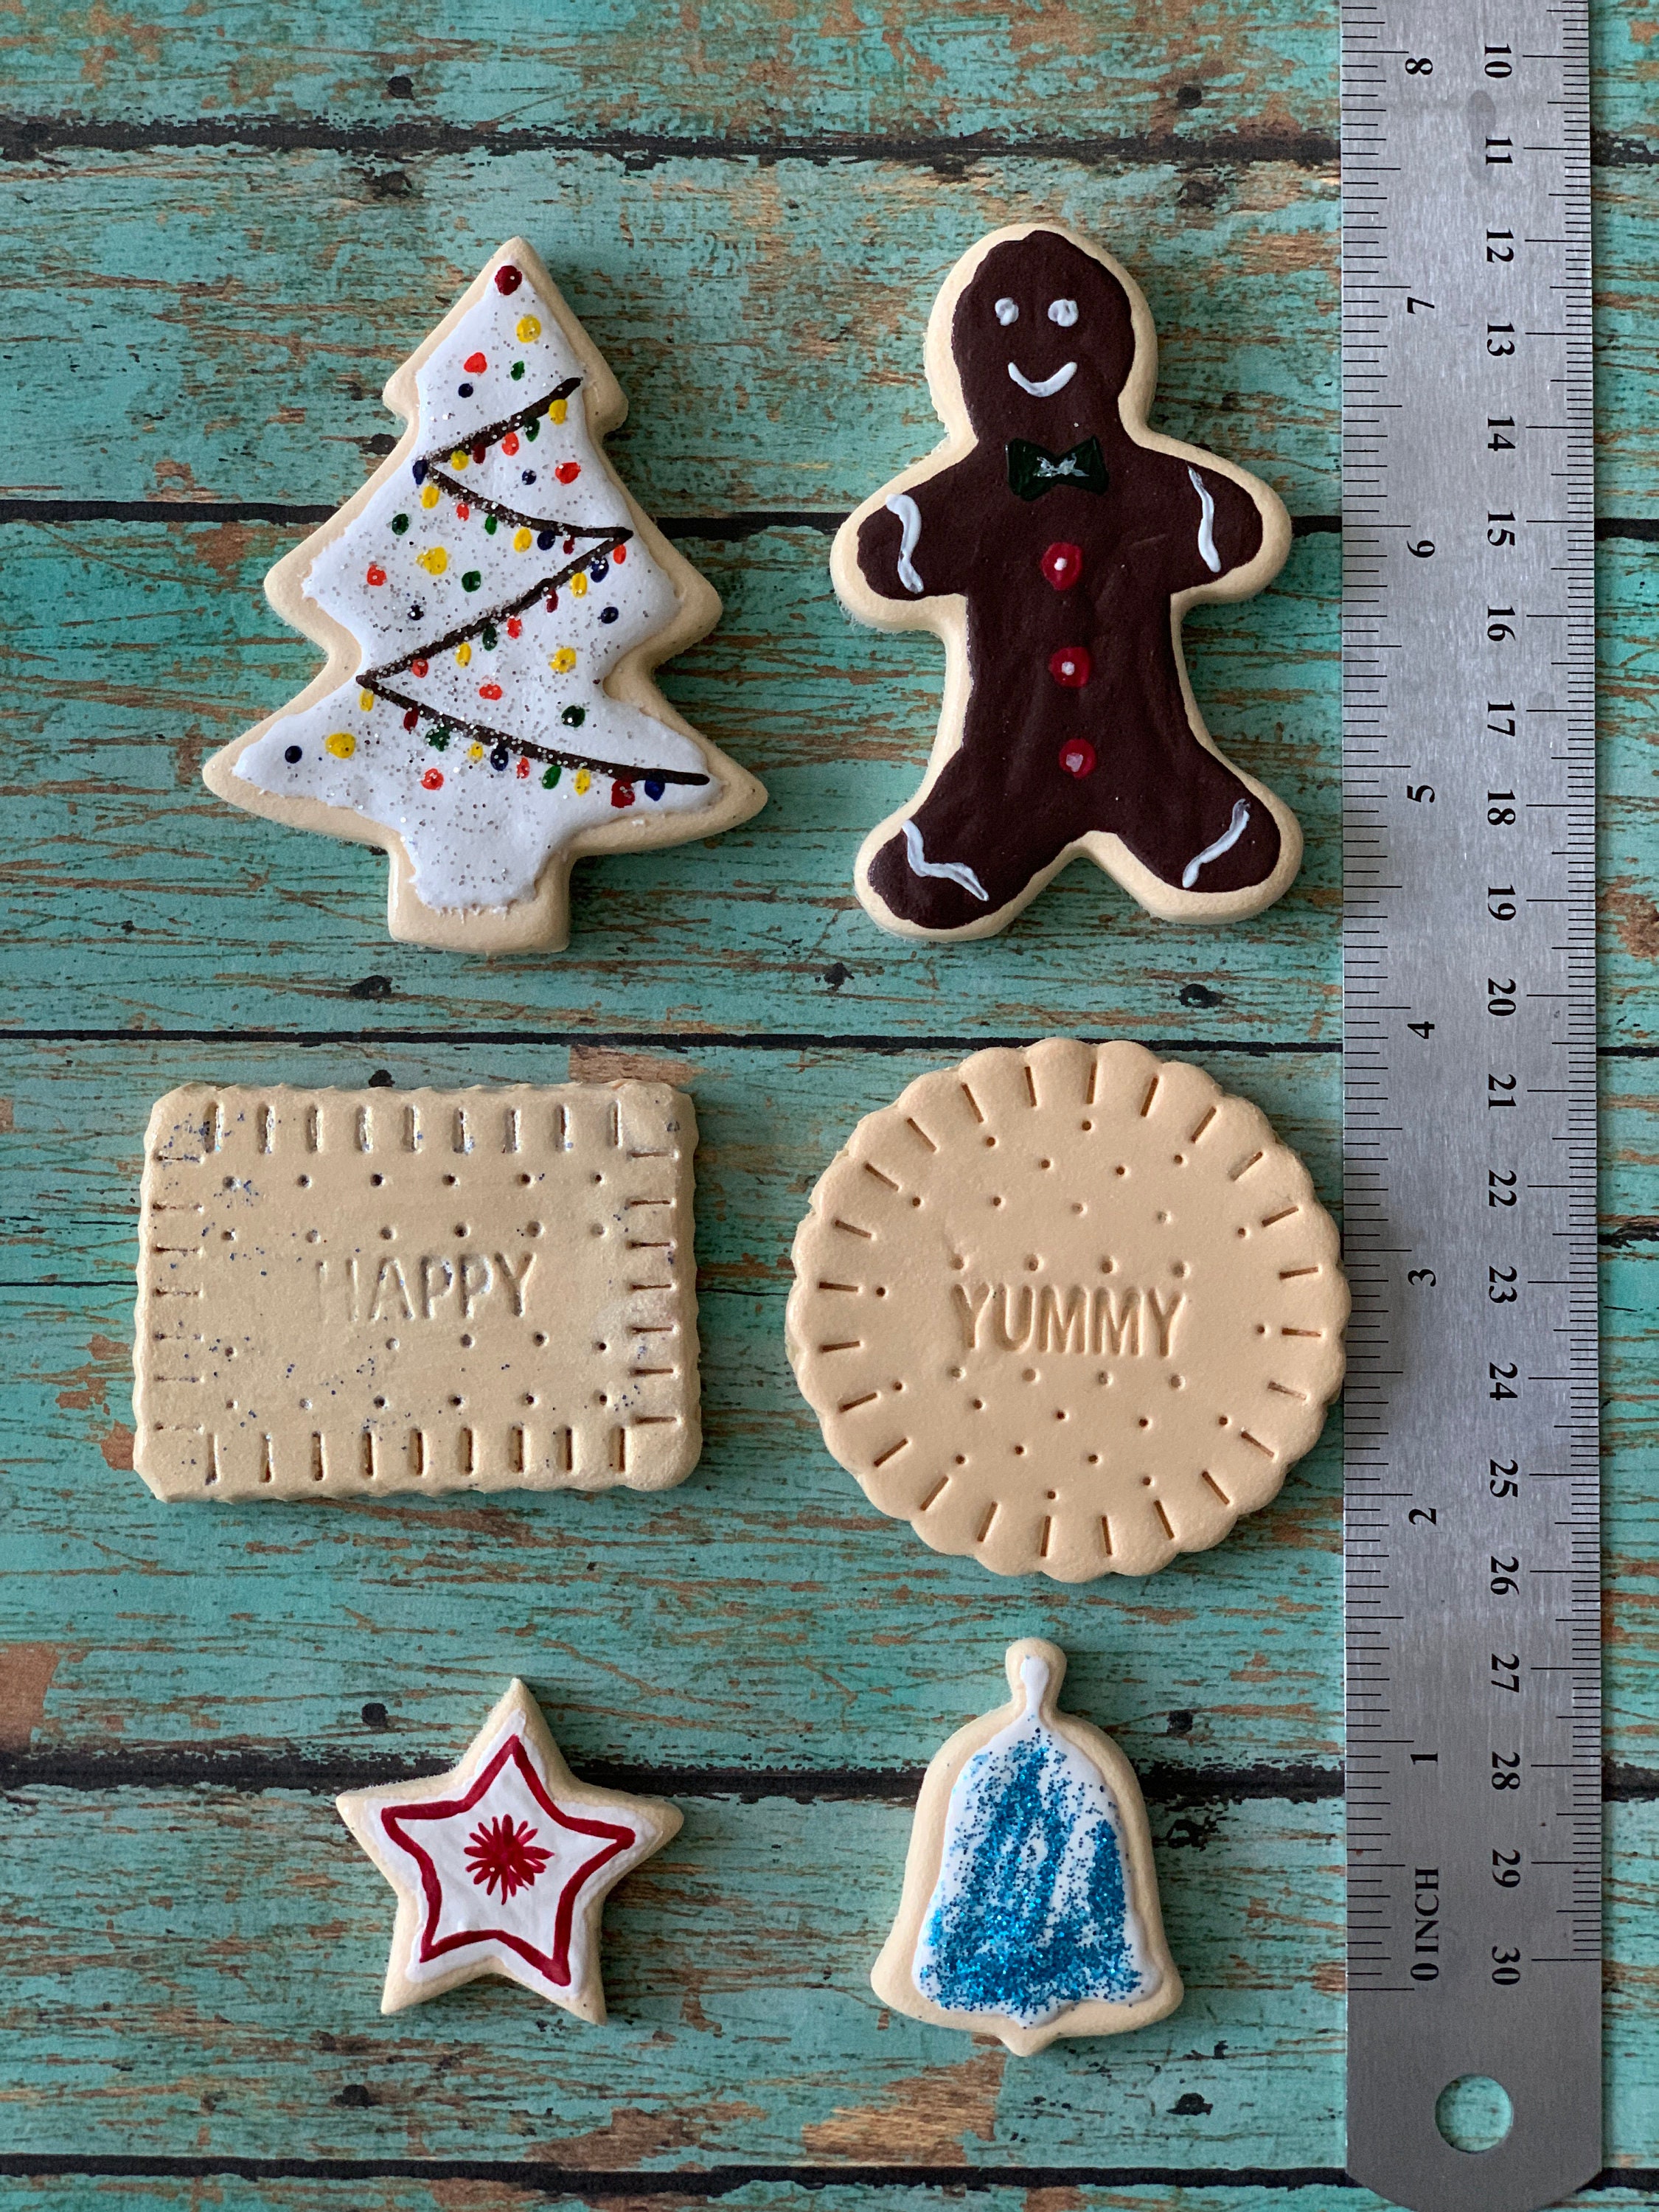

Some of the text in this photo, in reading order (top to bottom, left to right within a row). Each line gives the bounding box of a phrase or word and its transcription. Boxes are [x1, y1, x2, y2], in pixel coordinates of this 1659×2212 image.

[1405, 58, 1433, 76] 8
[1484, 43, 1513, 79] 10
[1484, 136, 1514, 166] 11
[1486, 228, 1514, 264] 12
[1407, 296, 1436, 315] 7
[1486, 321, 1515, 357] 13
[1487, 415, 1516, 452] 14
[1486, 510, 1516, 547] 15
[1406, 540, 1436, 558] 6
[1486, 605, 1516, 642] 16
[1486, 700, 1516, 737] 17
[1406, 785, 1436, 804] 5
[1486, 789, 1516, 826] 18
[1487, 884, 1517, 921] 19
[1487, 978, 1517, 1017] 20
[1407, 1020, 1436, 1040] 4
[1488, 1073, 1517, 1110] 21
[1488, 1169, 1517, 1208] 22
[1407, 1268, 1436, 1287] 3
[1488, 1265, 1518, 1304] 23
[950, 1283, 1186, 1357] YUMMY
[1489, 1362, 1518, 1401] 24
[1489, 1458, 1519, 1498] 25
[1408, 1507, 1437, 1526] 2
[1490, 1555, 1520, 1596] 26
[1490, 1653, 1520, 1693] 27
[1410, 1753, 1439, 1765] 1
[1491, 1750, 1521, 1790] 28
[1492, 1848, 1521, 1888] 29
[1410, 1868, 1440, 1982] 0 INCH
[1491, 1945, 1521, 1986] 30
